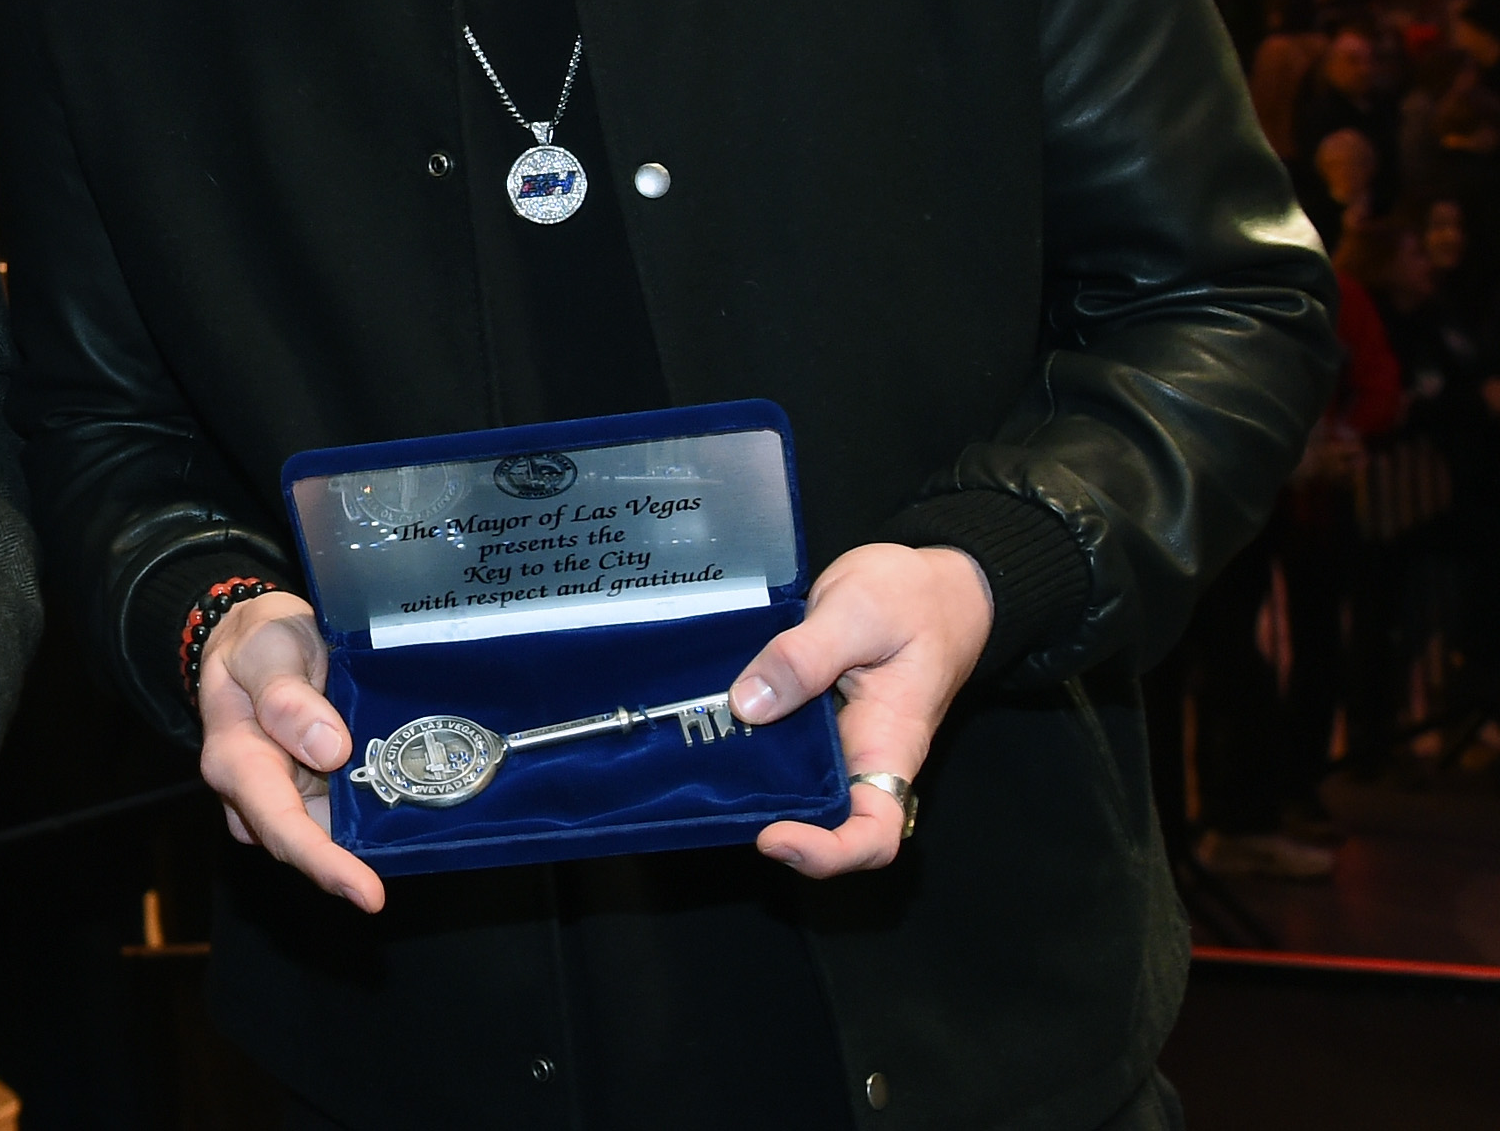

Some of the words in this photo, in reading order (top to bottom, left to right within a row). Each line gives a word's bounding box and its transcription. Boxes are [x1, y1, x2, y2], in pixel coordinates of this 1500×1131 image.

[392, 520, 440, 542] The
[450, 513, 531, 541] Mayor
[539, 504, 568, 528] of
[572, 505, 617, 523] Las
[626, 496, 702, 519] Vegas
[478, 532, 578, 563] presents
[588, 525, 625, 545] the
[464, 565, 512, 585] Key
[521, 563, 544, 577] to
[554, 553, 591, 574] the
[600, 550, 651, 573] City
[401, 591, 458, 614] with
[465, 586, 548, 609] respect
[557, 575, 602, 597] and
[607, 563, 724, 597] gratitude
[387, 738, 403, 760] CITY
[402, 727, 416, 739] OF
[420, 721, 443, 732] LAS
[449, 721, 482, 745] VEGAS
